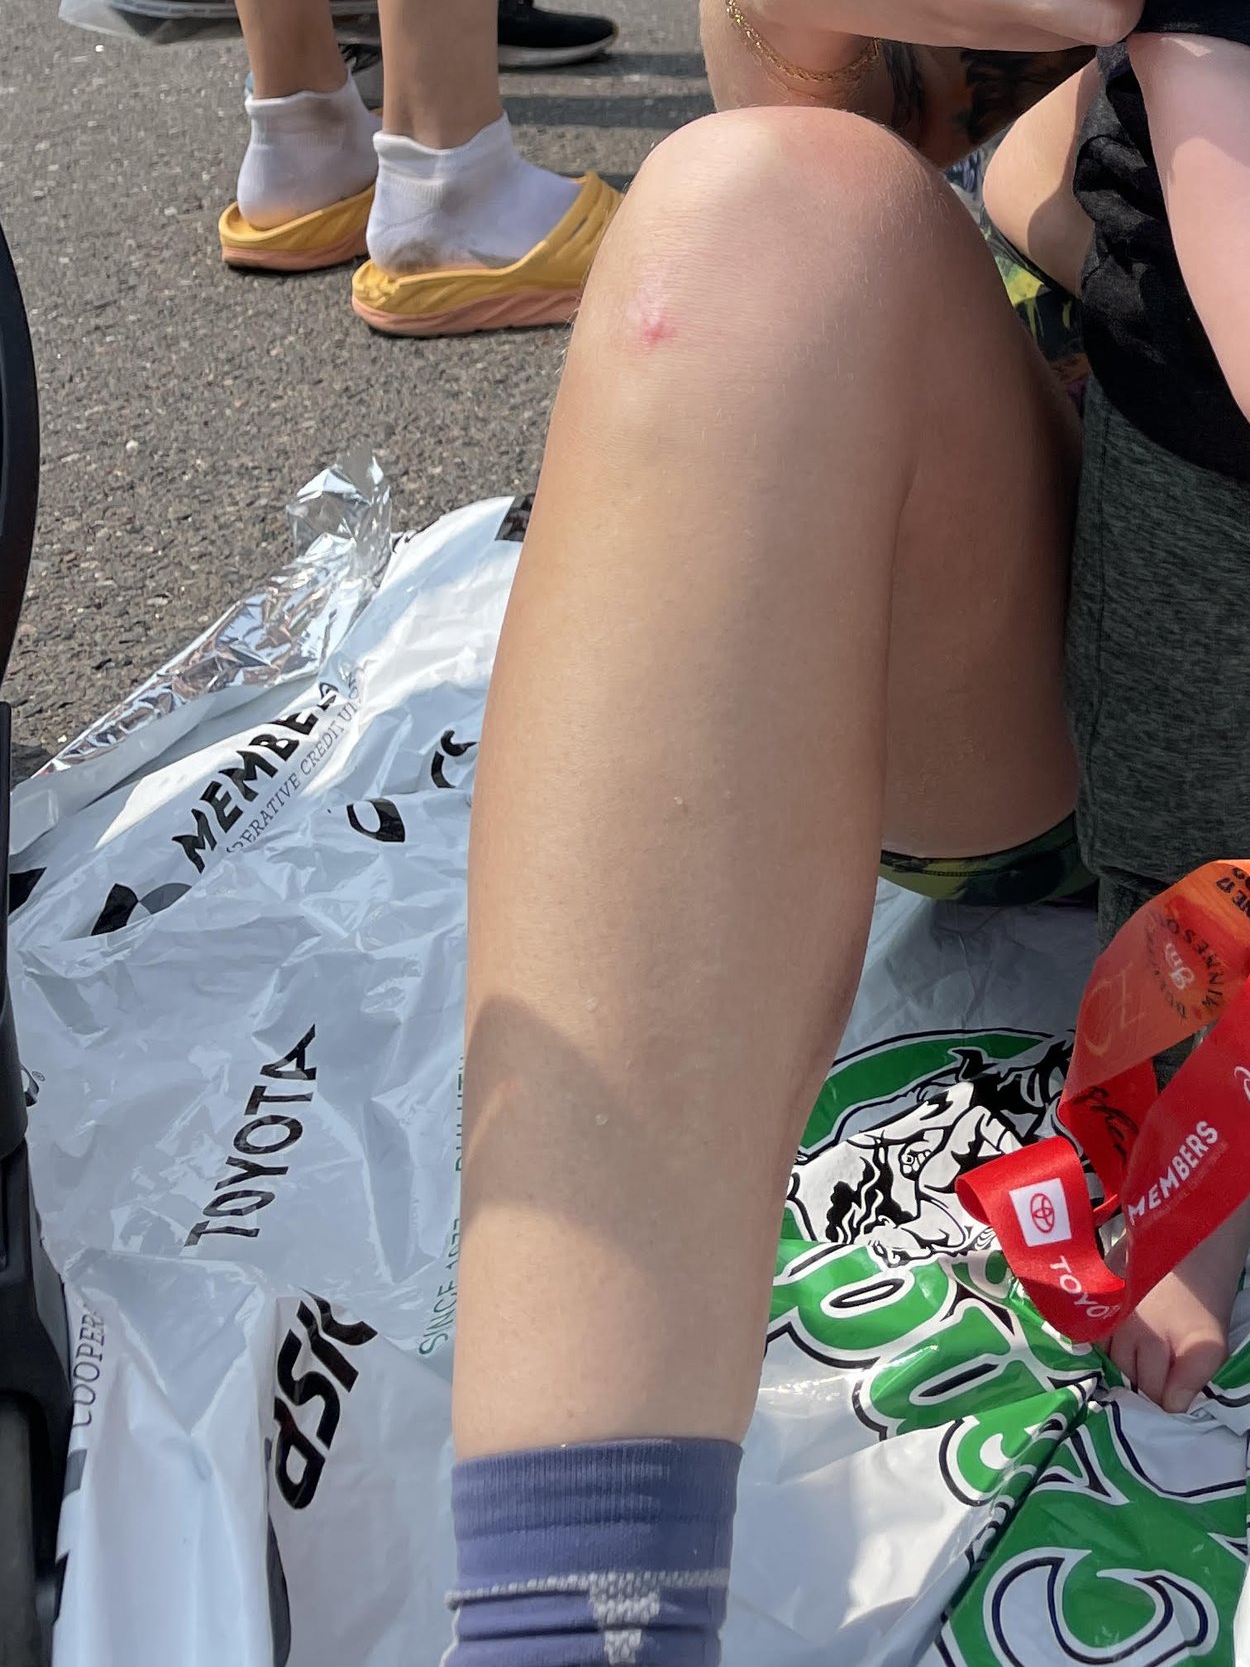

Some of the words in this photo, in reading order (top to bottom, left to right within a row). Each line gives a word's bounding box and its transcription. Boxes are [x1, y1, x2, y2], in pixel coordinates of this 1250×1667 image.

[171, 681, 338, 874] MEMBE
[299, 722, 343, 777] CREDIT
[183, 1023, 318, 1248] TOYOTA
[1126, 1119, 1219, 1227] MEMBERS
